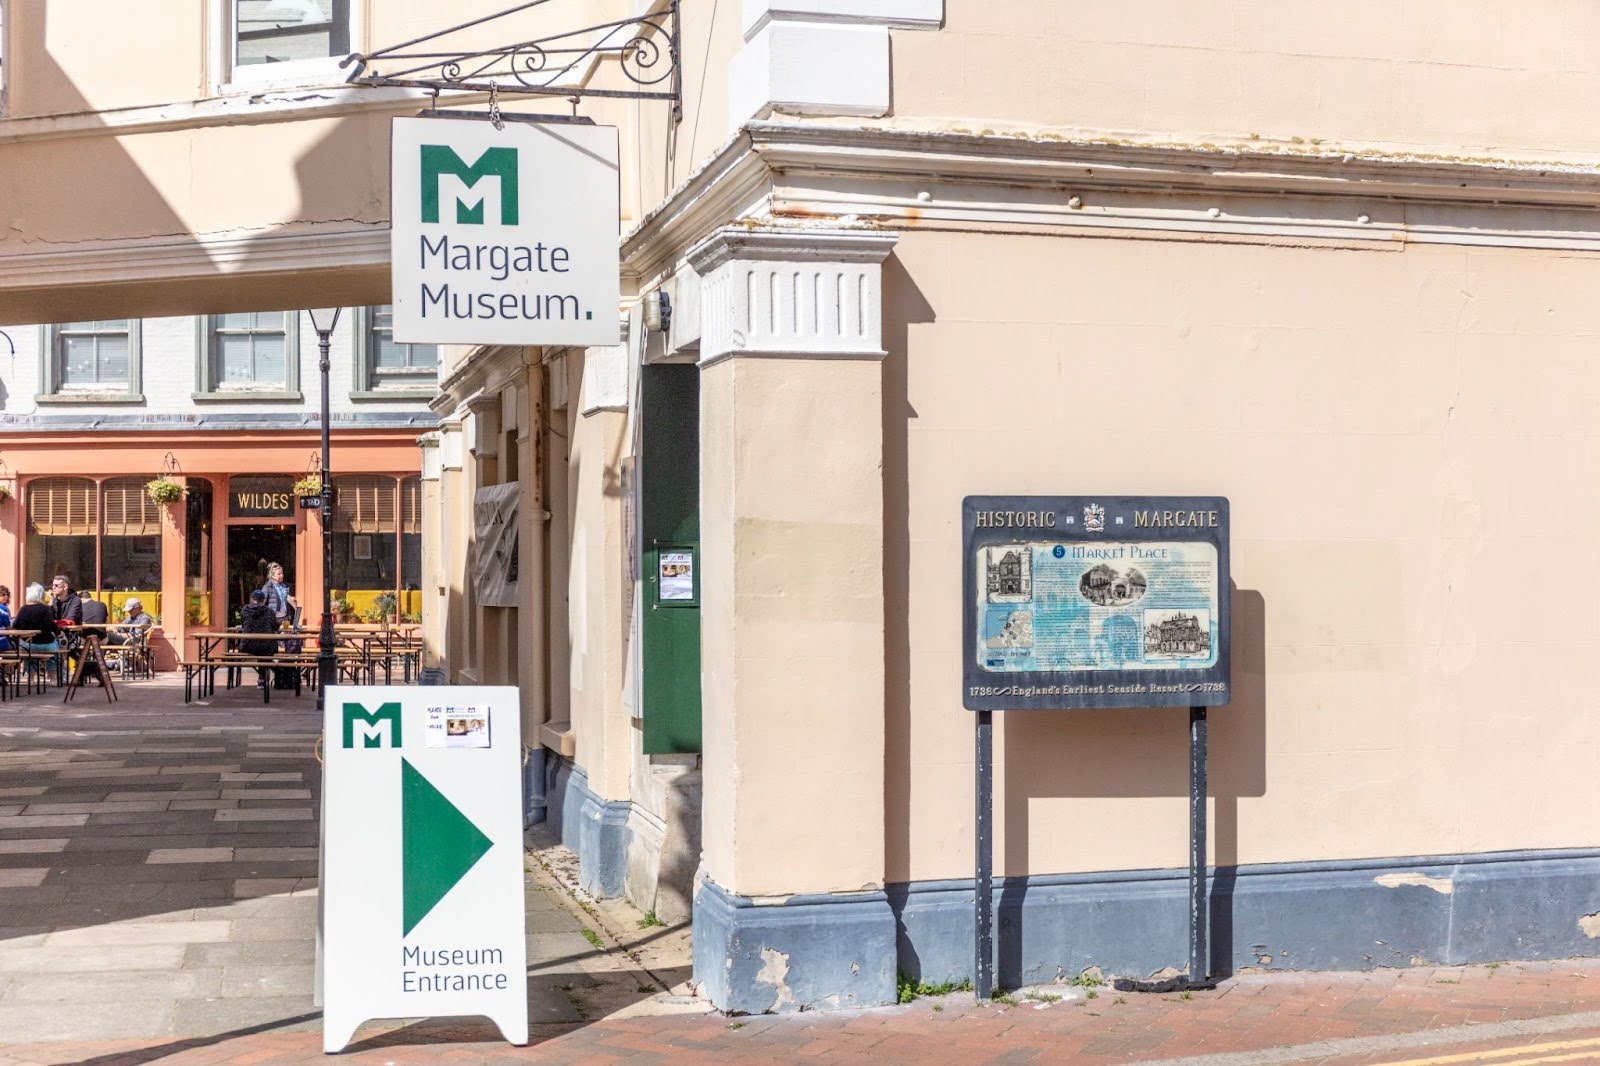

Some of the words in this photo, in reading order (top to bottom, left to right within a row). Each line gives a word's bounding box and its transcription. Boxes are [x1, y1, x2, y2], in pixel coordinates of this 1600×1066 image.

[420, 234, 569, 281] Margate
[420, 283, 593, 321] Museum.
[237, 492, 289, 510] WILDES
[976, 511, 1056, 528] HISTORIC
[1134, 510, 1218, 528] MARGATE
[1055, 547, 1062, 557] 5
[1012, 685, 1060, 698] England's
[1062, 684, 1104, 696] Earliest
[1108, 683, 1147, 695] Seaside
[1149, 683, 1184, 694] Resort
[402, 945, 504, 967] Museum
[402, 970, 508, 993] Entrance
